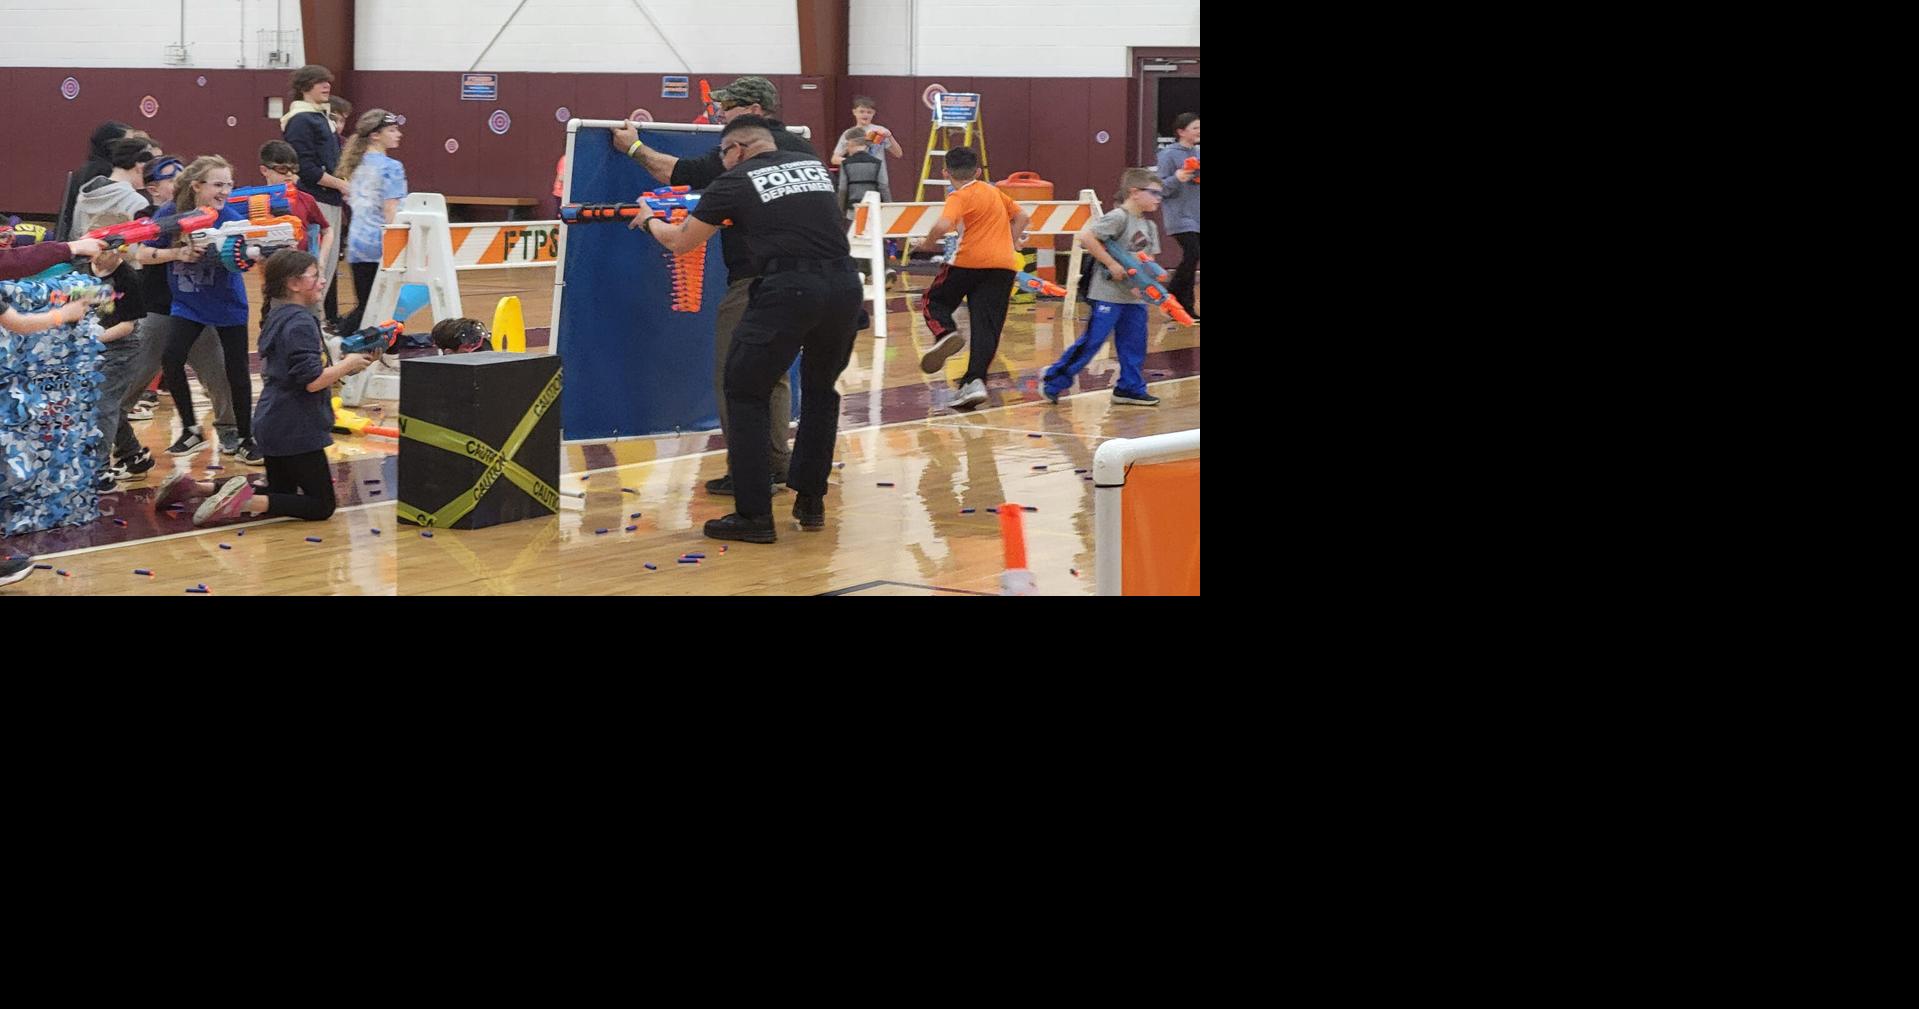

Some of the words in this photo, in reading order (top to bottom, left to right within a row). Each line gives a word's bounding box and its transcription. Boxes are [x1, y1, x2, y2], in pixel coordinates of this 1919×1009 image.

[752, 167, 832, 194] POLICE
[760, 182, 835, 203] DEPARTMEN
[503, 228, 559, 260] FTPS
